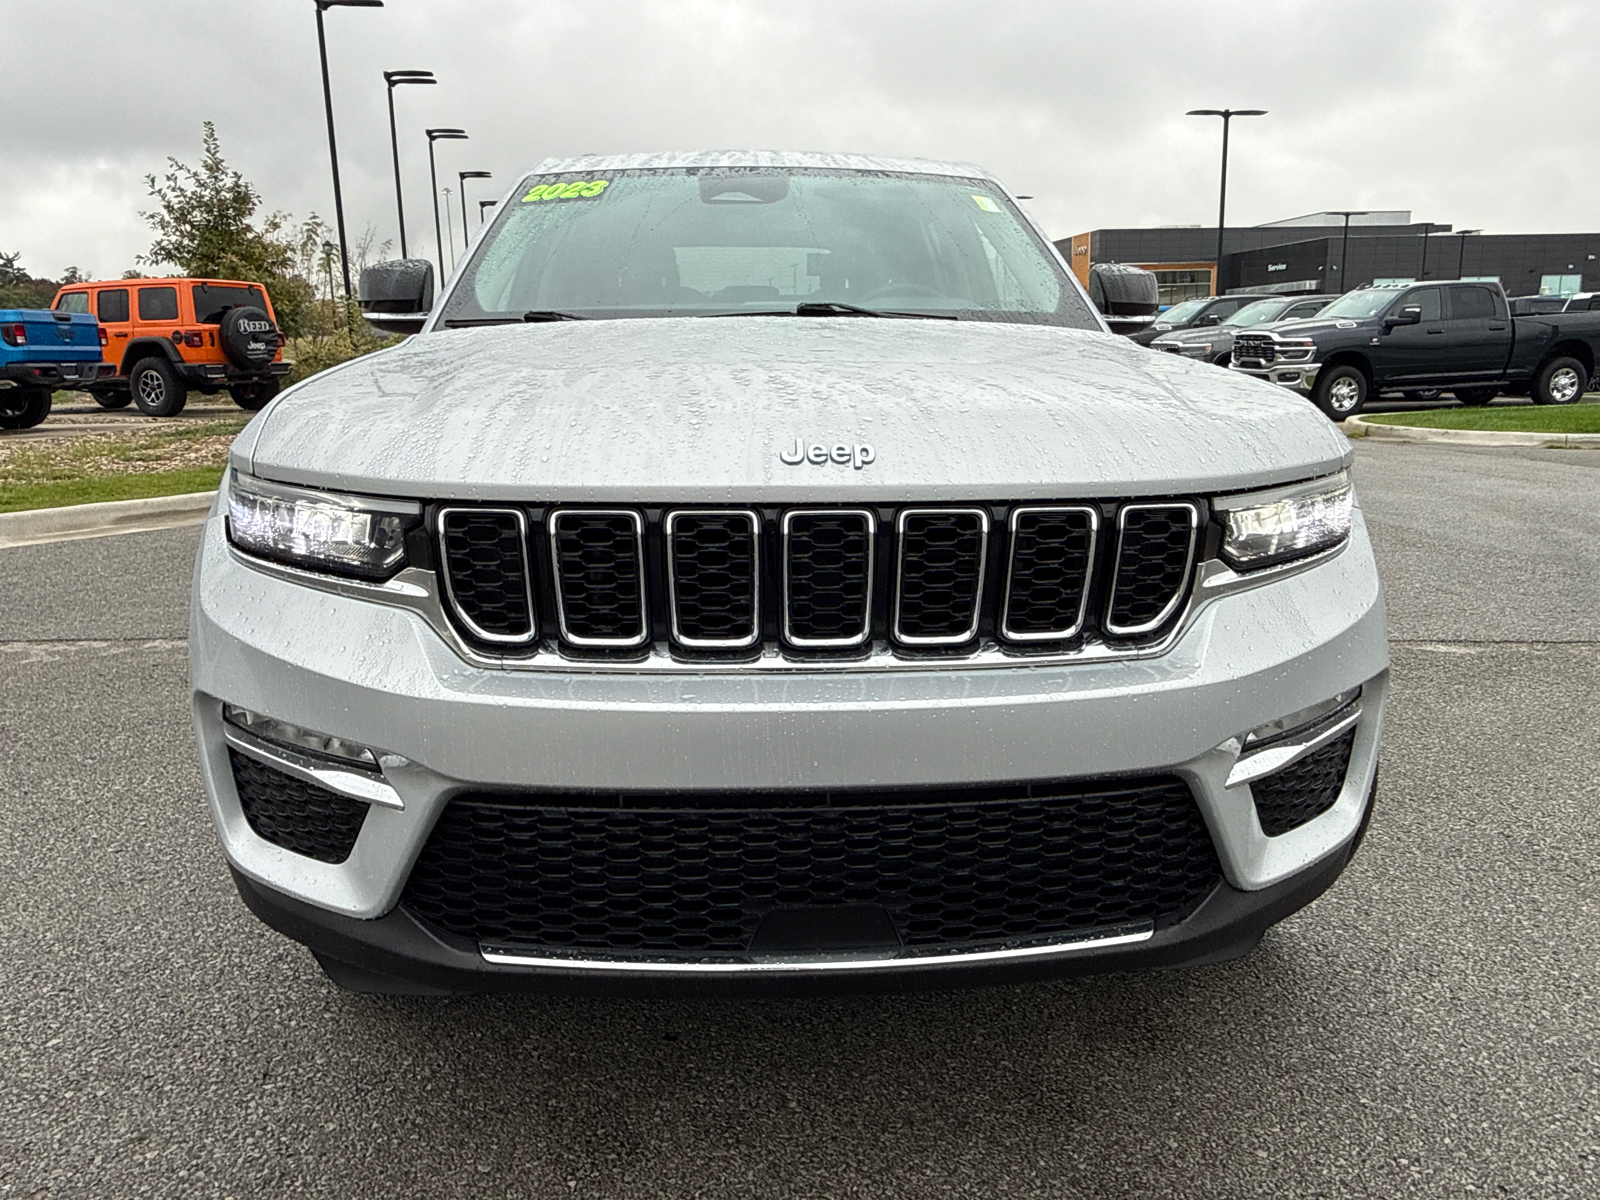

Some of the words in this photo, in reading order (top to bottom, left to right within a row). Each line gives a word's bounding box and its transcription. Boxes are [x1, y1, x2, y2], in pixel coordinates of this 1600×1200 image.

[521, 180, 609, 202] 2023
[1267, 263, 1287, 271] Service
[238, 318, 270, 334] REED
[247, 341, 266, 350] Jeep
[779, 438, 876, 470] Jeep
